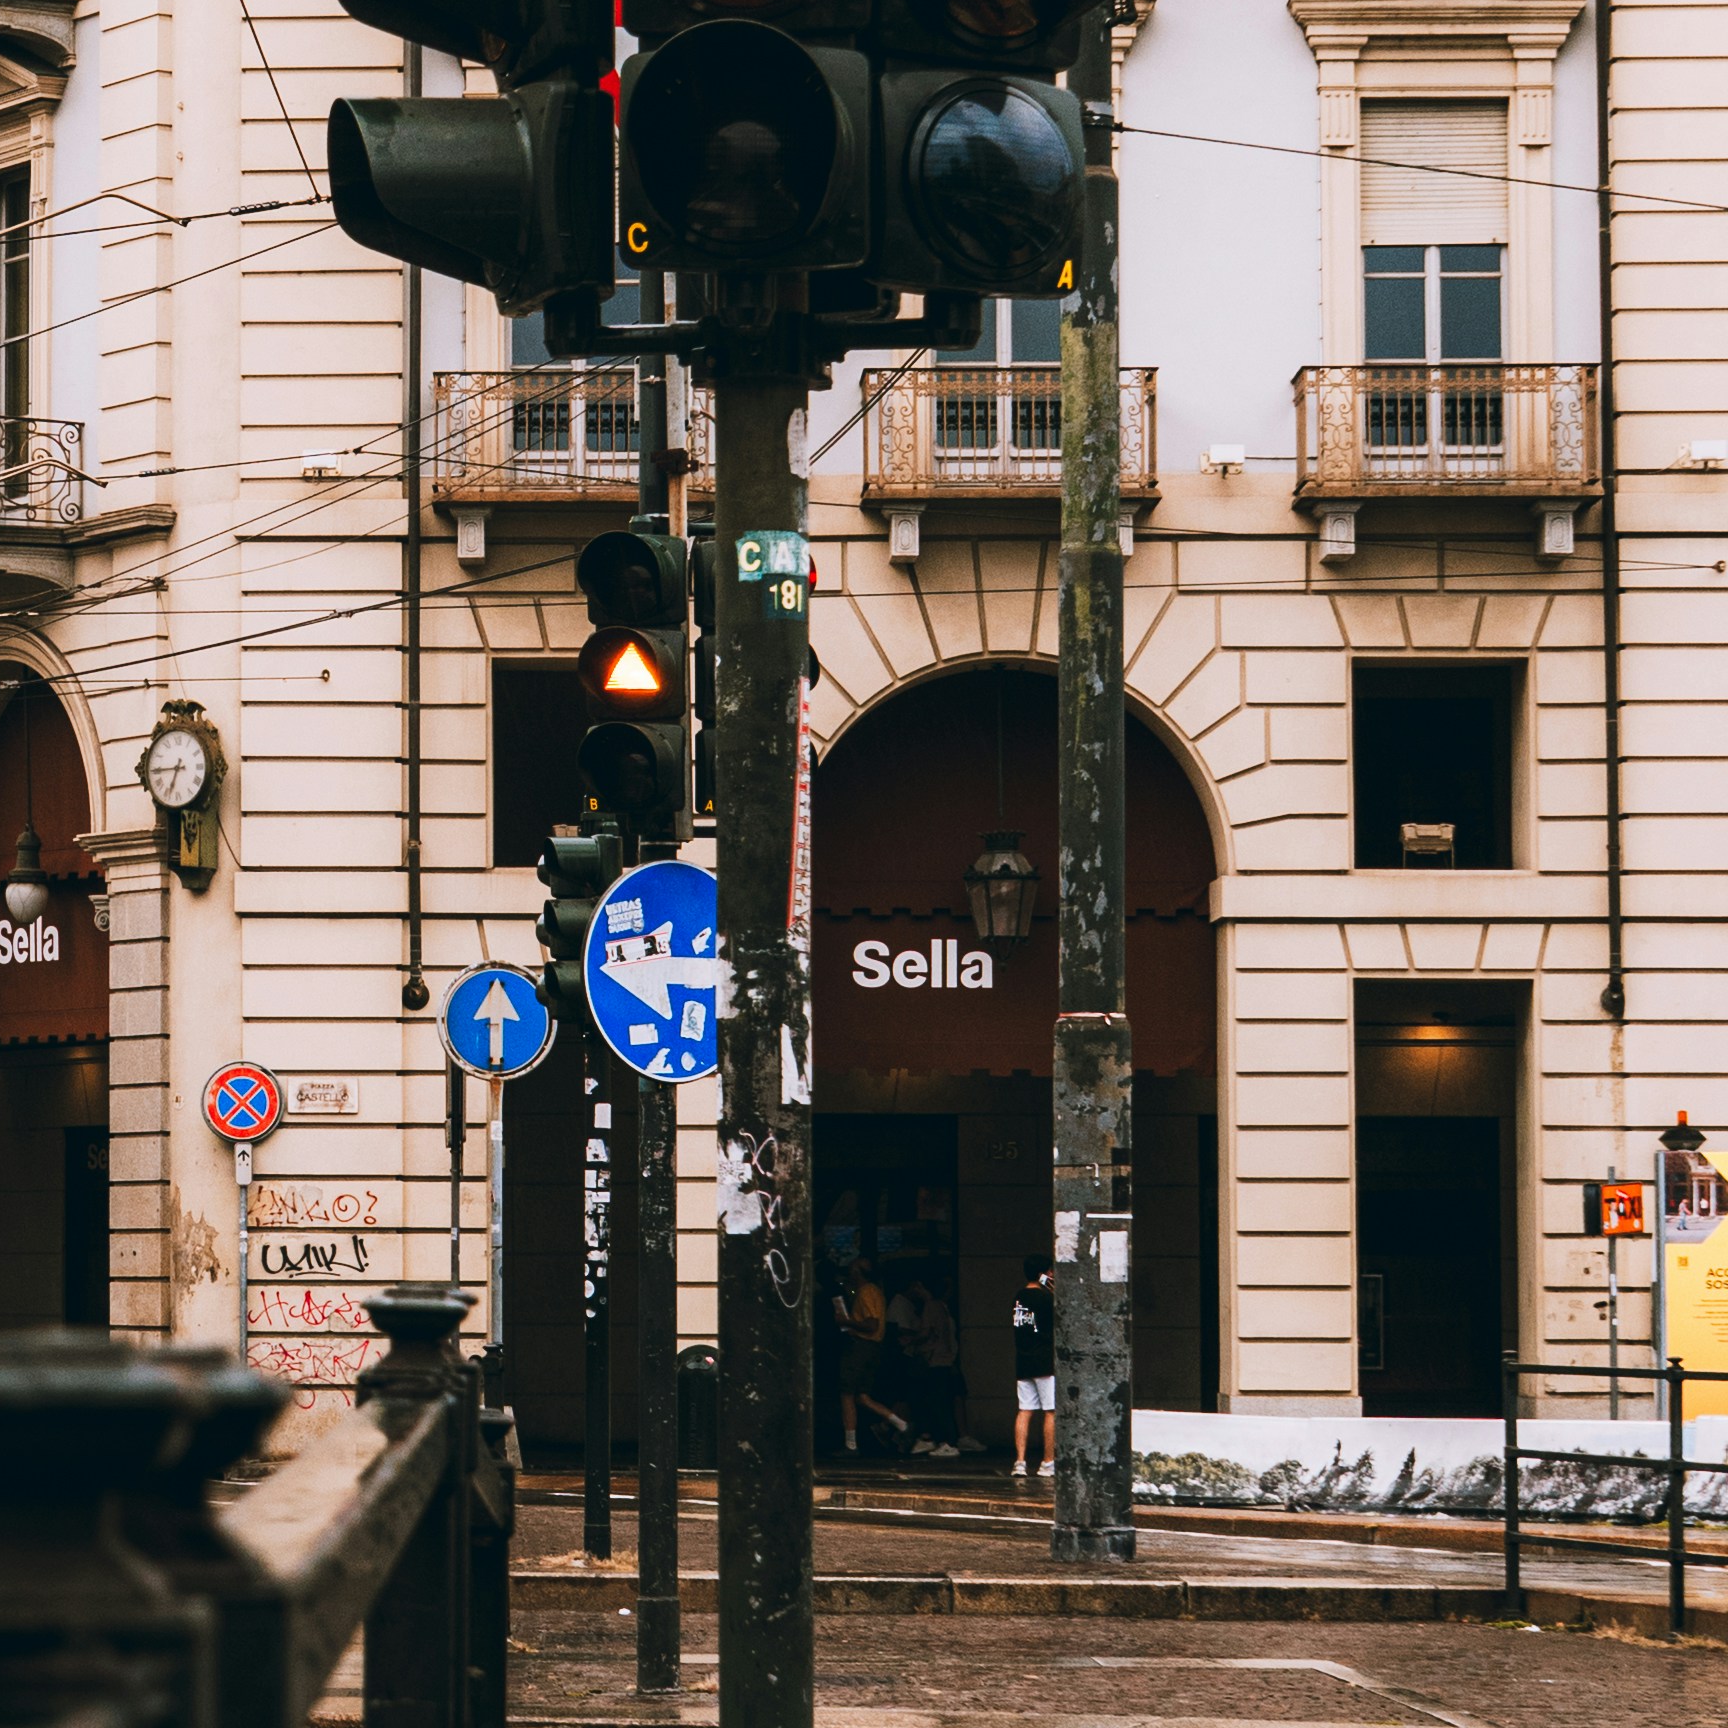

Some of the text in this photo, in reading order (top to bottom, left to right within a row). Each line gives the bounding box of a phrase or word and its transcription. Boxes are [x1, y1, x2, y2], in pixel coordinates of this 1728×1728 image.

[628, 222, 649, 253] C
[1057, 260, 1074, 290] A
[589, 798, 598, 811] B
[704, 799, 714, 812] A
[852, 939, 993, 989] Sella
[296, 1092, 349, 1102] CASTELLO
